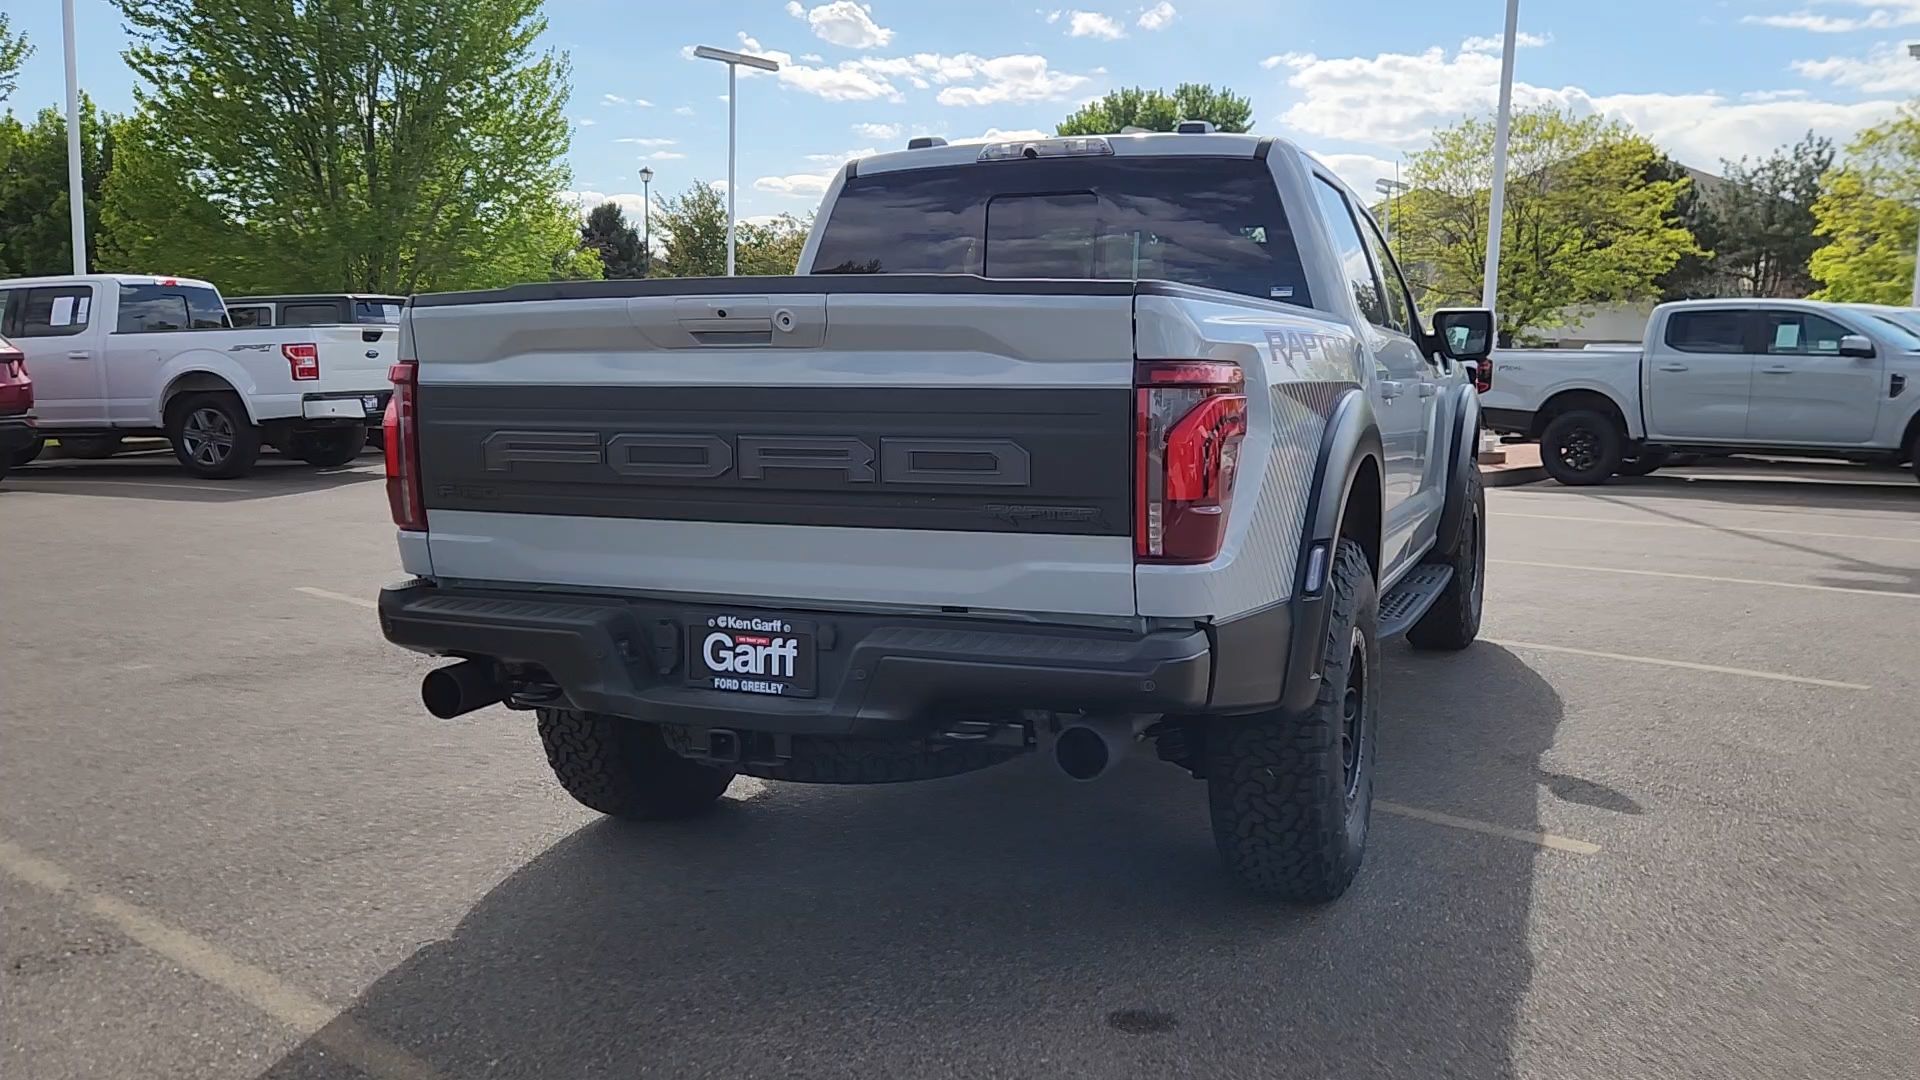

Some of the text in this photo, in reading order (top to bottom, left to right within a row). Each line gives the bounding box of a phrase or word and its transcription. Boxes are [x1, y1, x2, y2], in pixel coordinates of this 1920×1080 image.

[482, 430, 1031, 487] FORD
[984, 503, 1104, 525] RAPTOR
[728, 616, 782, 632] Ken Garff
[703, 632, 798, 677] Garff
[714, 677, 784, 694] FORD GREELEY
